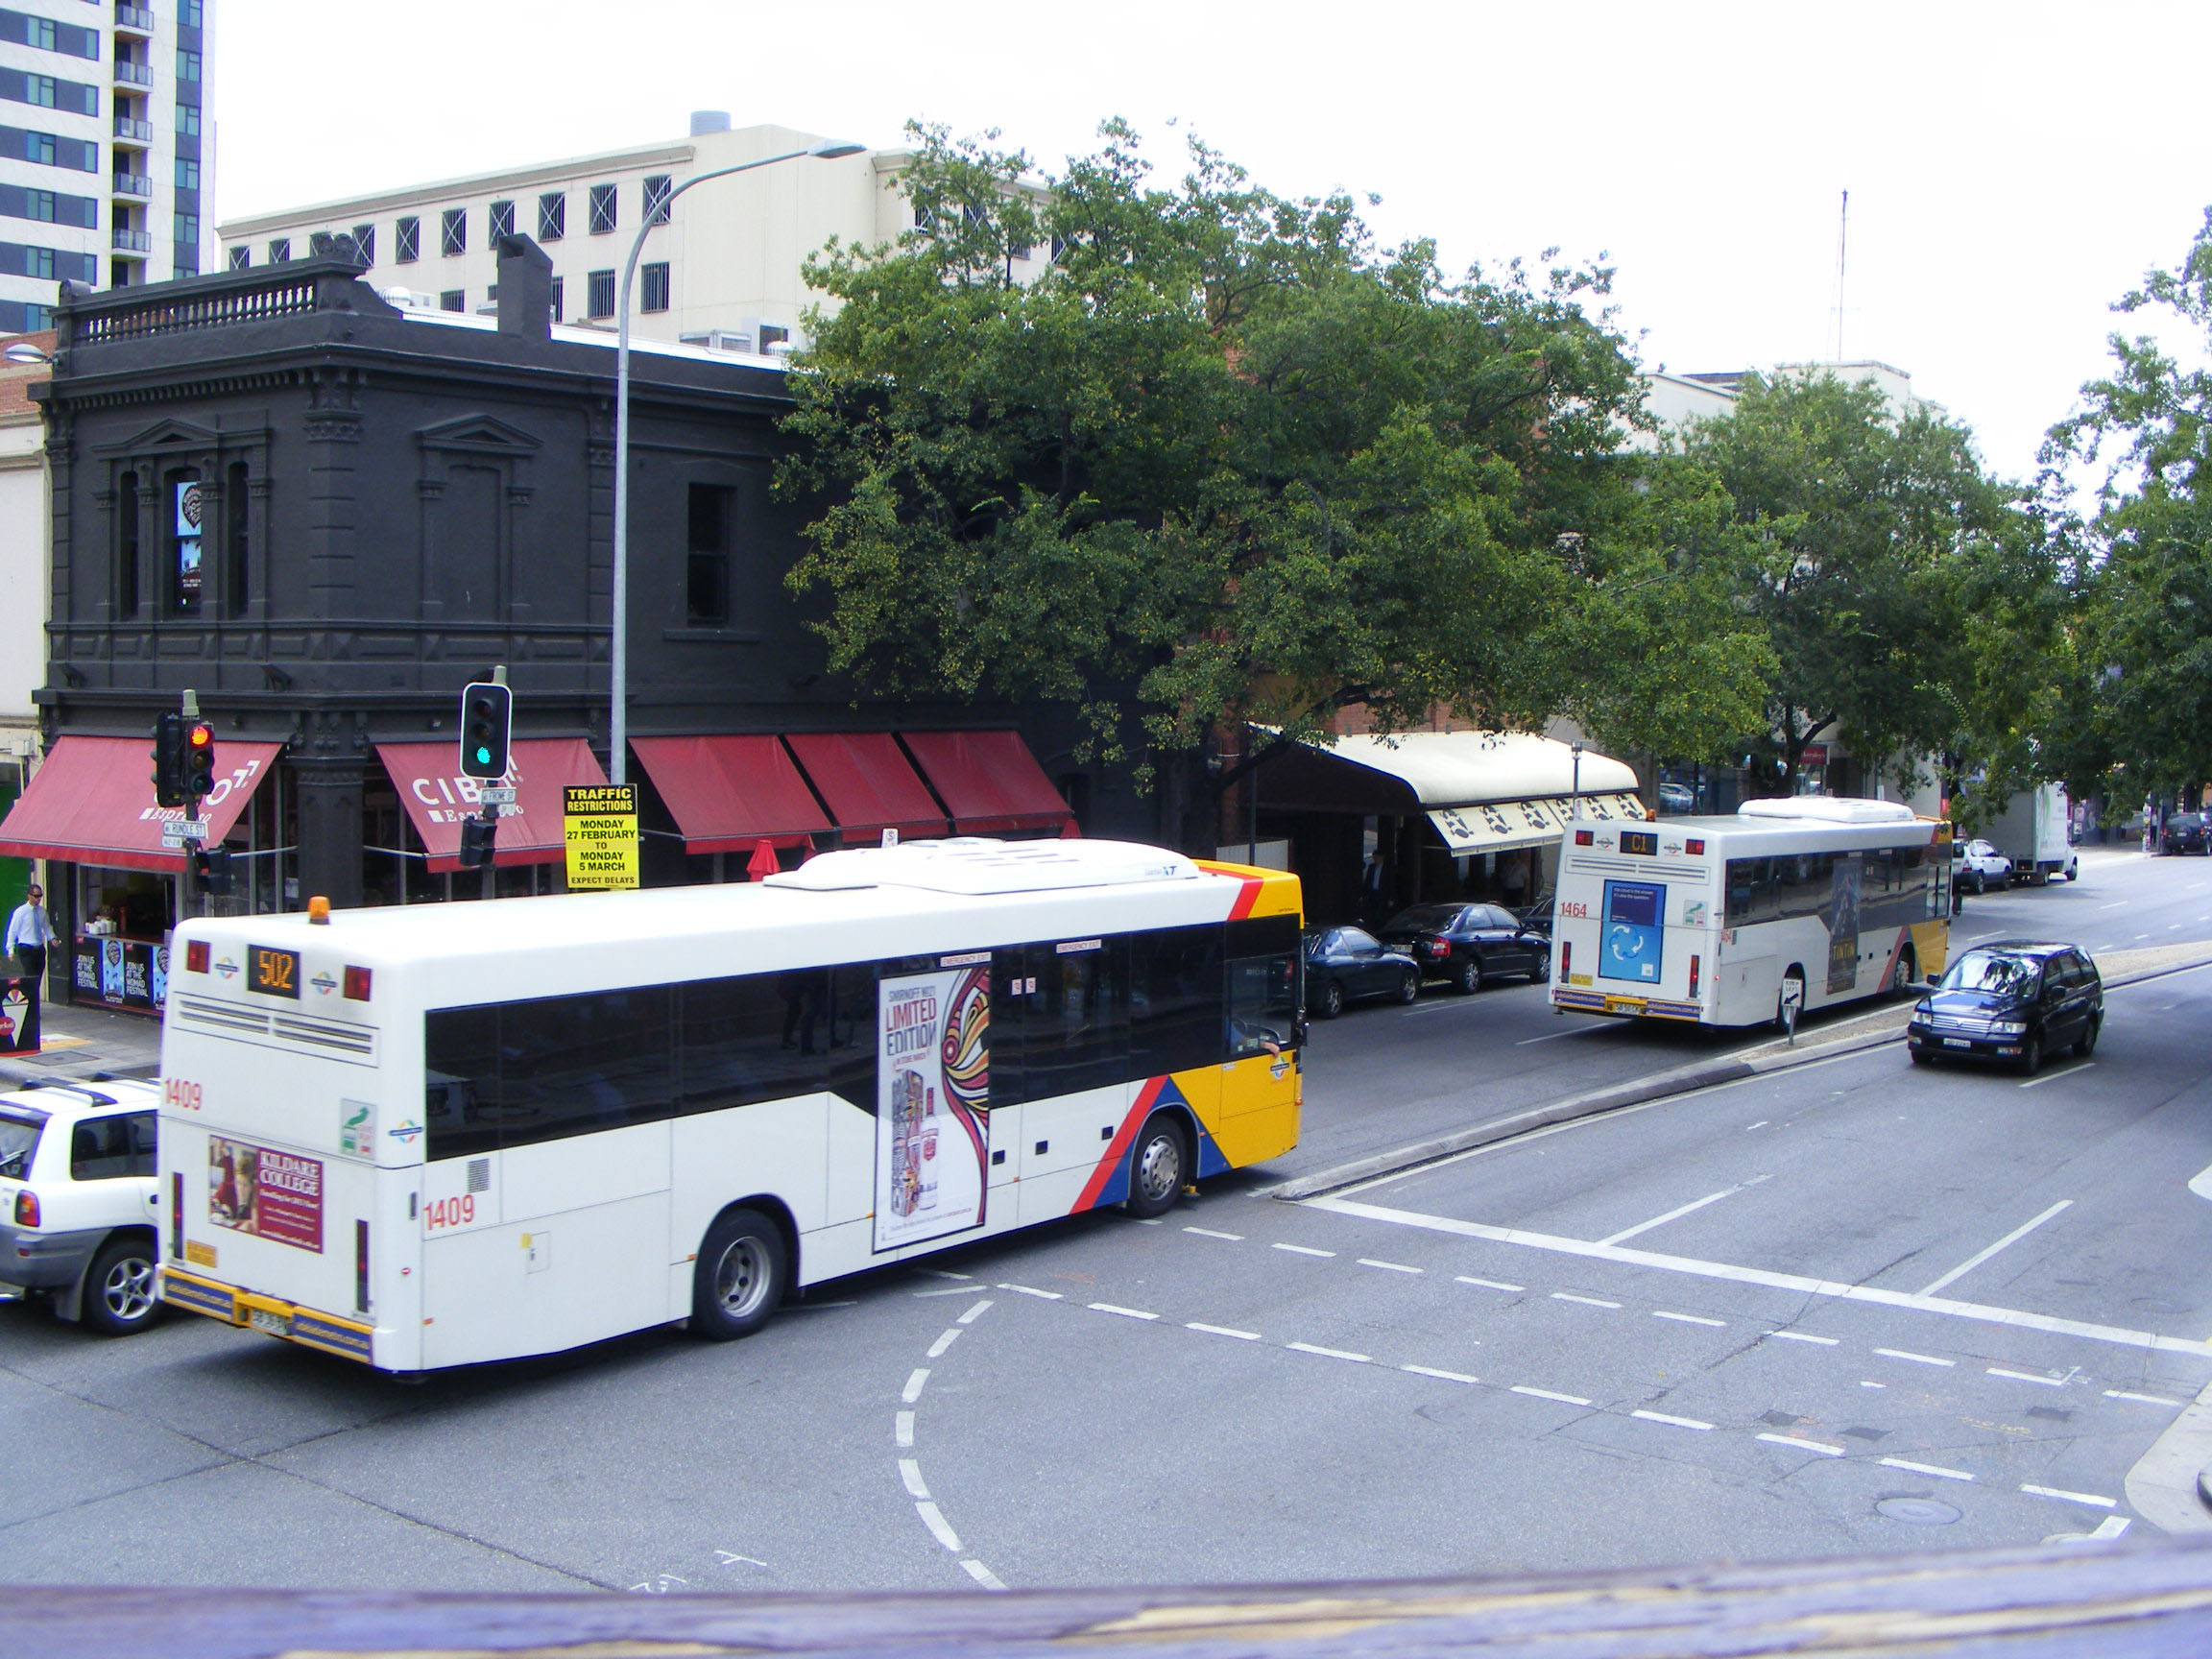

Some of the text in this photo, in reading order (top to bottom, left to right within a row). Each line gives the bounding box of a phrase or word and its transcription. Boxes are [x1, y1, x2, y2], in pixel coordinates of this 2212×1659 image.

[567, 787, 632, 800] TRAFFIC
[567, 800, 633, 812] RESTRICTIONS
[172, 824, 204, 835] RUNDLE ST
[580, 819, 625, 829] MONDAY
[566, 830, 636, 840] 27 FEBRUARY
[594, 841, 608, 850] TO
[1631, 833, 1647, 853] C1
[580, 852, 624, 861] MONDAY
[579, 862, 625, 871] 5 MARCH
[1560, 902, 1587, 918] 1464
[1057, 940, 1100, 952] EMERGENCY EXIT
[942, 953, 991, 966] EMERGENCY EXIT
[258, 950, 293, 989] 502
[77, 978, 99, 990] FESTIVAL
[126, 986, 149, 998] FESTIVAL
[885, 998, 937, 1032] LIMITED
[886, 1020, 937, 1056] EDITION
[164, 1077, 203, 1111] 1409
[259, 1151, 320, 1180] KILDARE
[259, 1168, 320, 1196] COLLEGE
[423, 1193, 475, 1231] 1409
